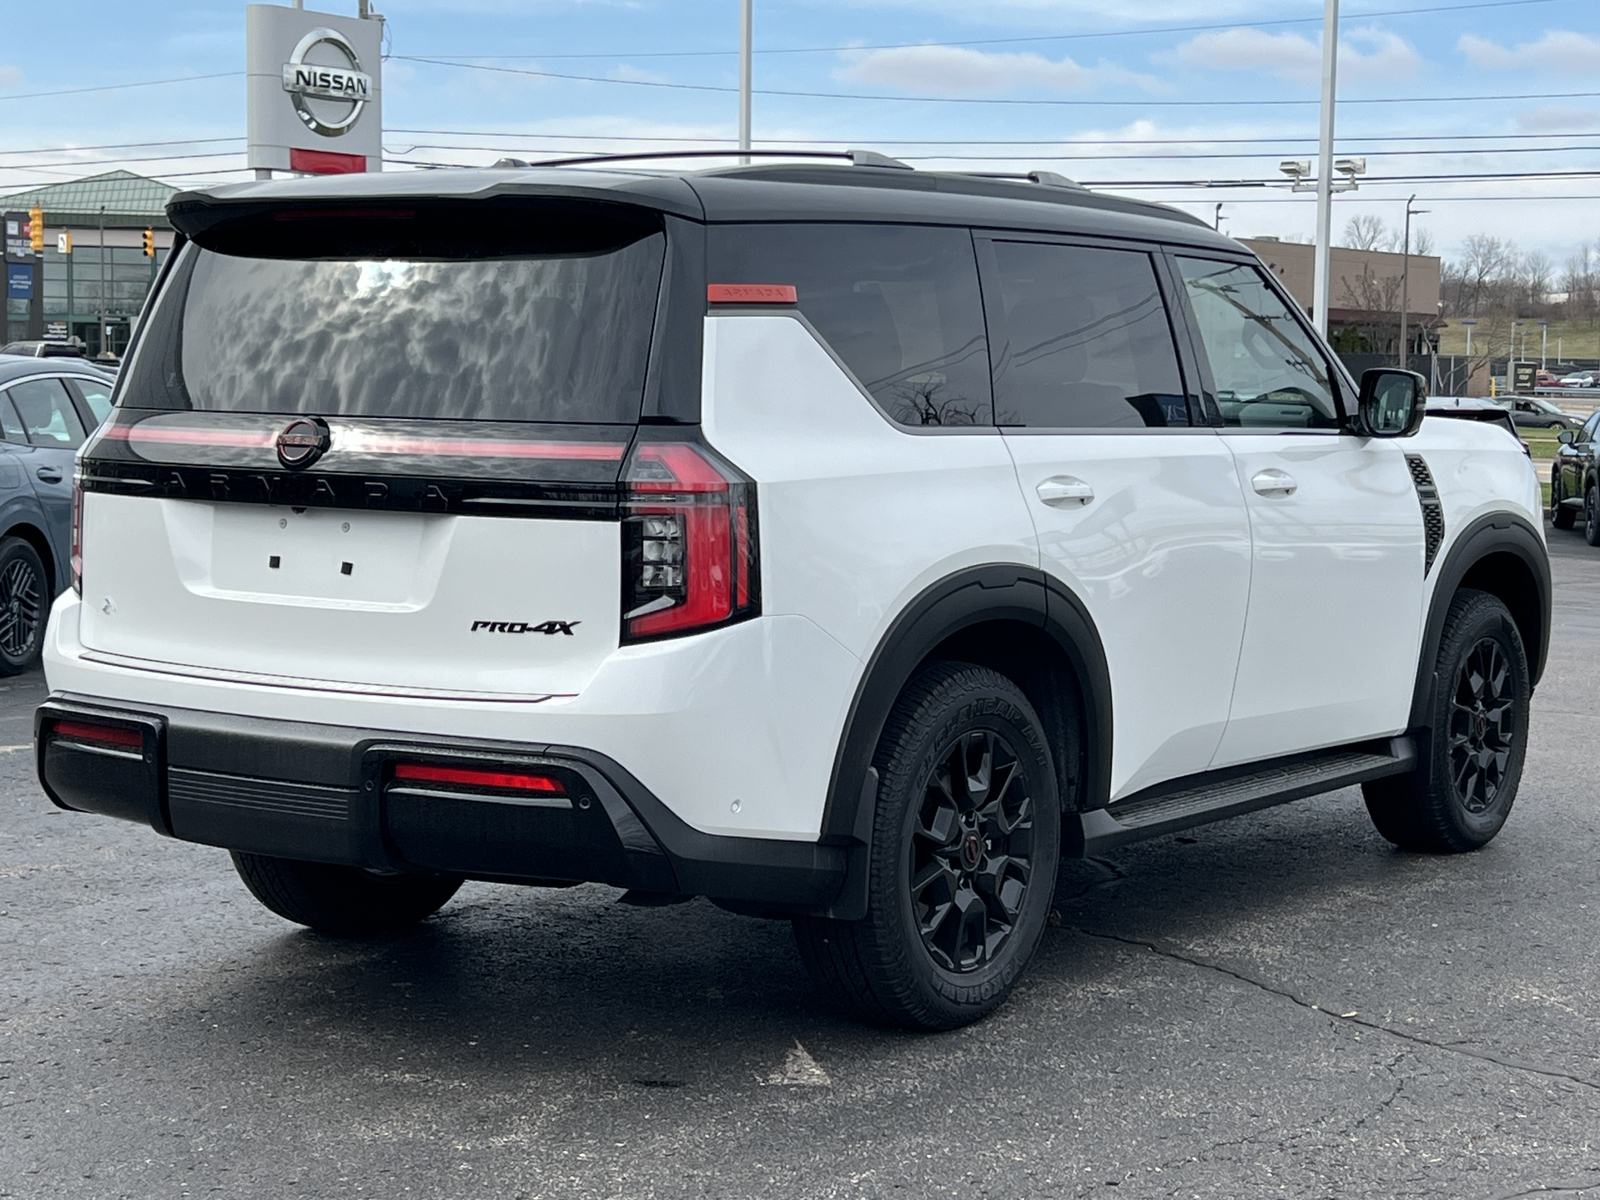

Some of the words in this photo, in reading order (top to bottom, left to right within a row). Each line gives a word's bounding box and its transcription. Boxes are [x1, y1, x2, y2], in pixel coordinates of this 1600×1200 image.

[296, 70, 367, 94] NISSAN
[723, 288, 784, 297] ARMADA
[277, 435, 319, 446] NISSAN
[163, 471, 449, 509] ARMADA
[471, 620, 582, 636] PRO-4X
[931, 954, 1025, 1004] YOKOHAMA
